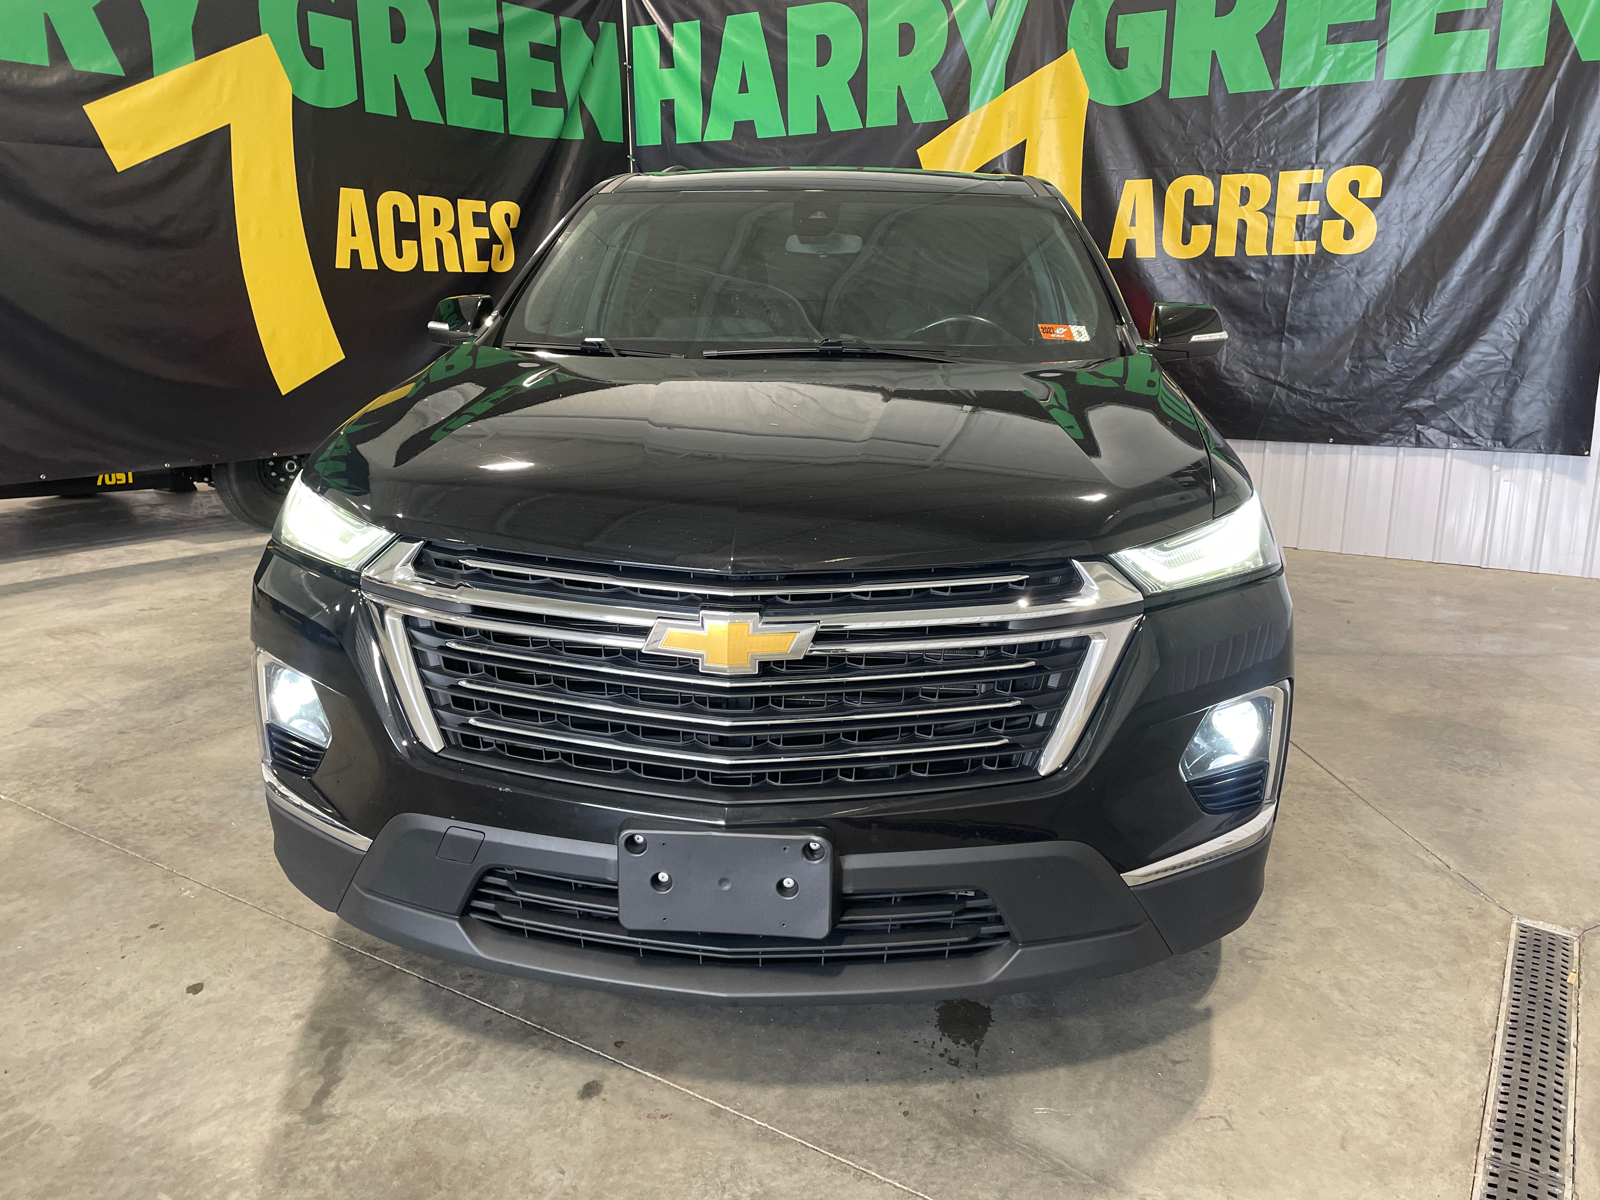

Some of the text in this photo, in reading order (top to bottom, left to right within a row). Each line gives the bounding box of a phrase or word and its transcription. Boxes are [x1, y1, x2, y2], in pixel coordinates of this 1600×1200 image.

[258, 0, 624, 143] GREEN
[632, 0, 1026, 146] HARRY
[83, 33, 521, 395] 7 ACRES
[1107, 165, 1383, 259] ACRES
